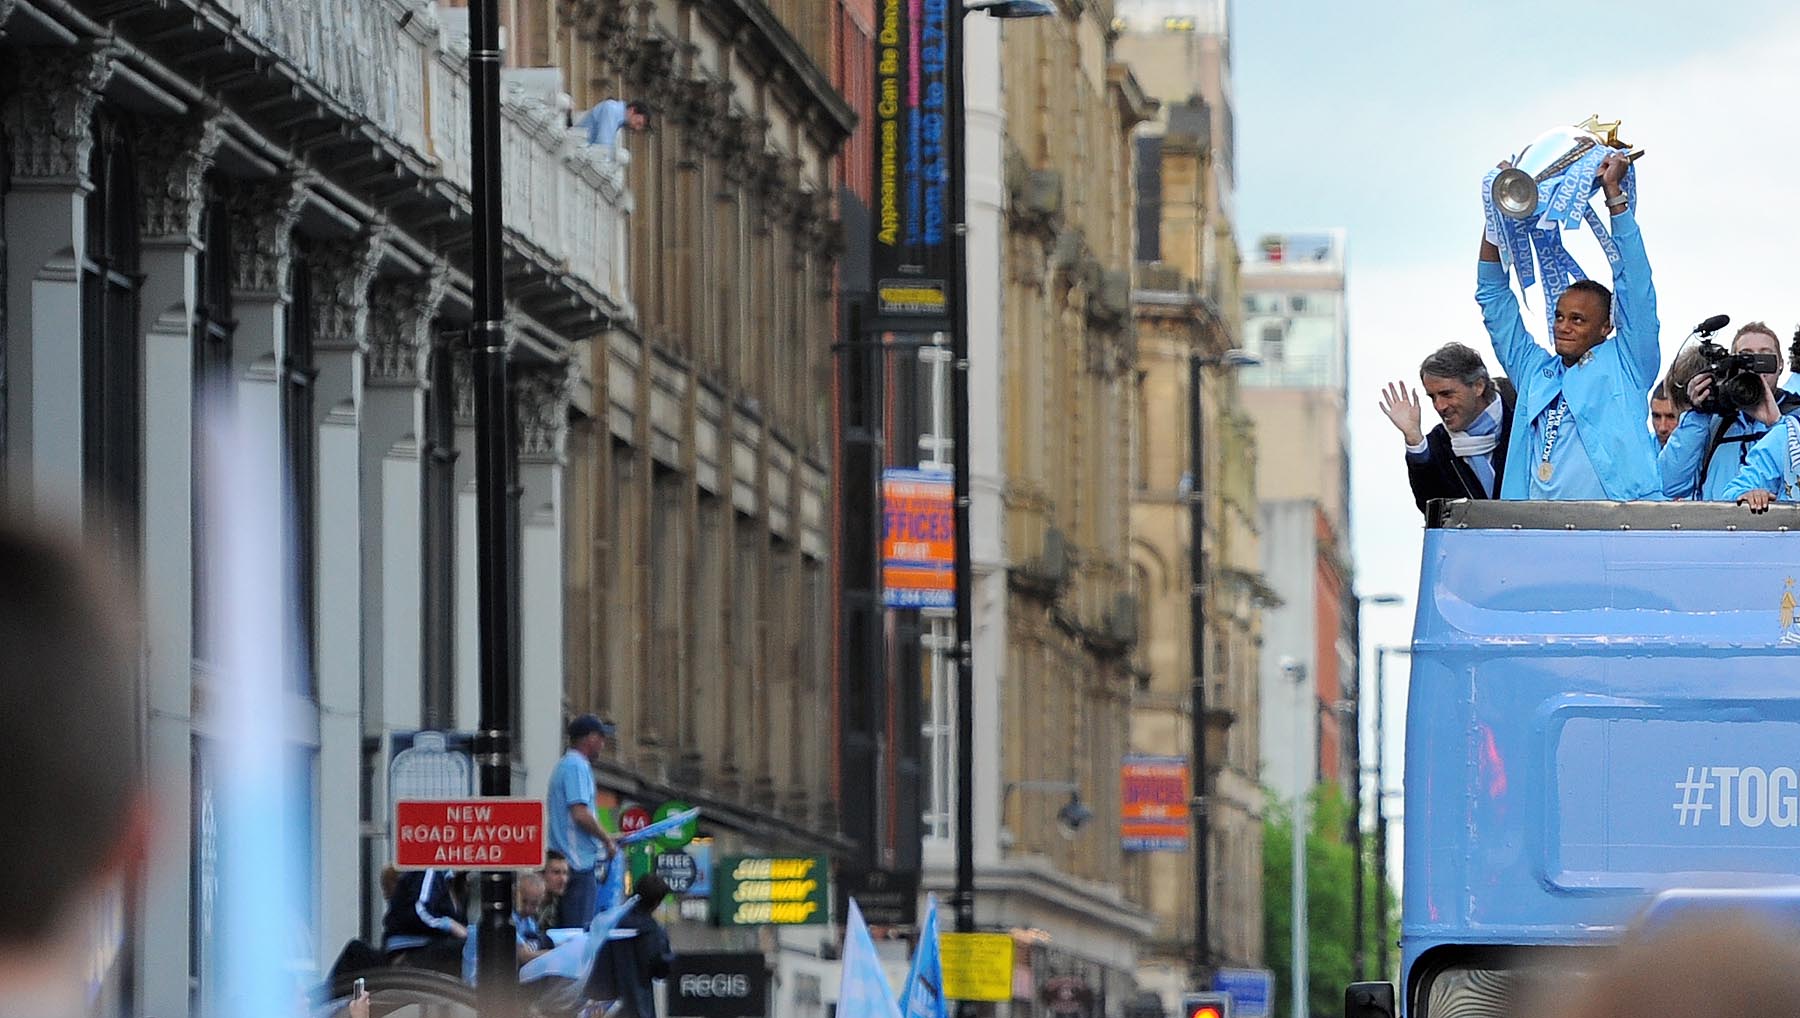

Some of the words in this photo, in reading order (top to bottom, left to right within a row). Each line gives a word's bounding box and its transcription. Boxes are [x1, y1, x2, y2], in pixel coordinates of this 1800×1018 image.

[880, 48, 898, 74] Be
[878, 78, 898, 119] Can
[884, 511, 953, 541] FFICES
[447, 806, 491, 822] NEW
[401, 826, 456, 842] ROAD
[463, 826, 537, 842] LAYOUT
[434, 846, 502, 862] AHEAD
[658, 854, 692, 868] FREE
[732, 858, 816, 880] SUBWAY
[732, 879, 817, 902] SUBWAY
[732, 901, 817, 924] SUBWAY
